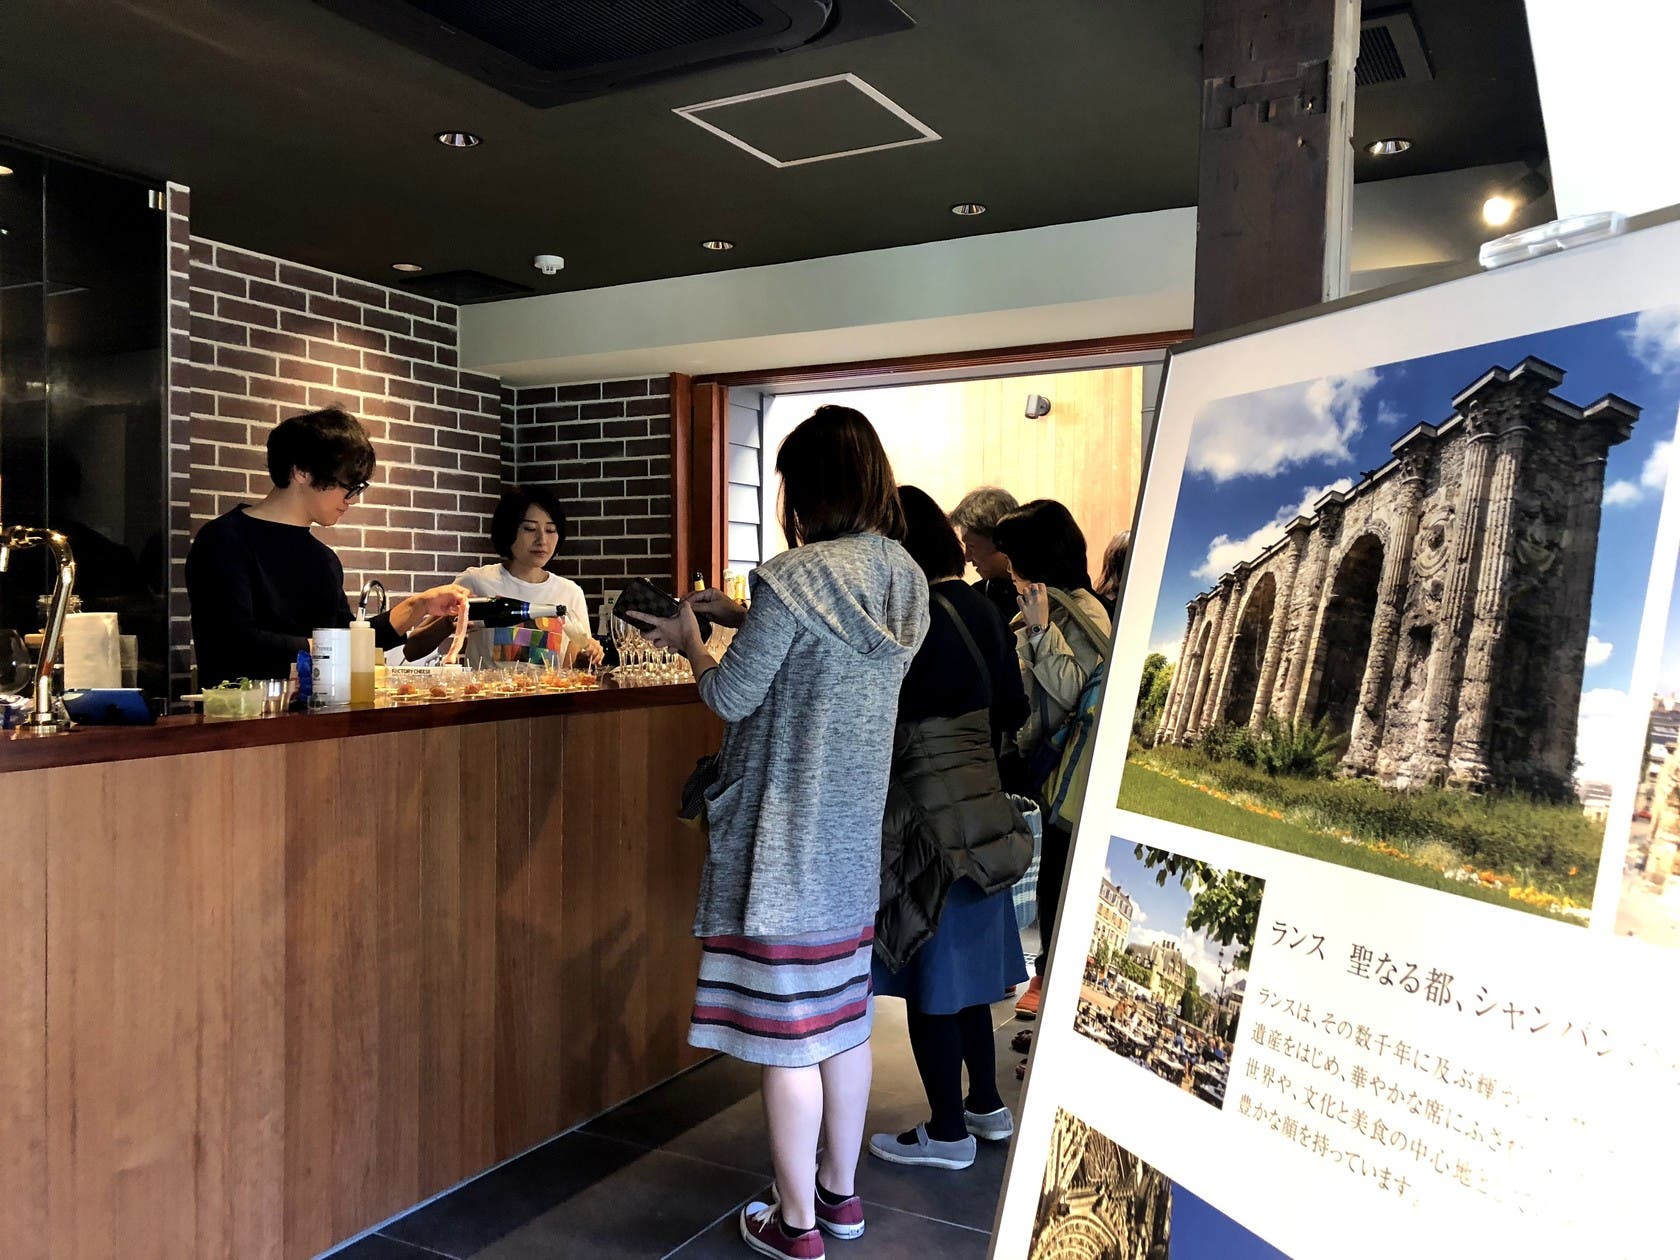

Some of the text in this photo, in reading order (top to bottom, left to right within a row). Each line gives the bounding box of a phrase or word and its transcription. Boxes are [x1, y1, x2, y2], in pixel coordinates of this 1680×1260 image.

[1271, 920, 1326, 961] ランス
[1250, 1021, 1524, 1155] 遺産をはじめ、華やかな席にふさ
